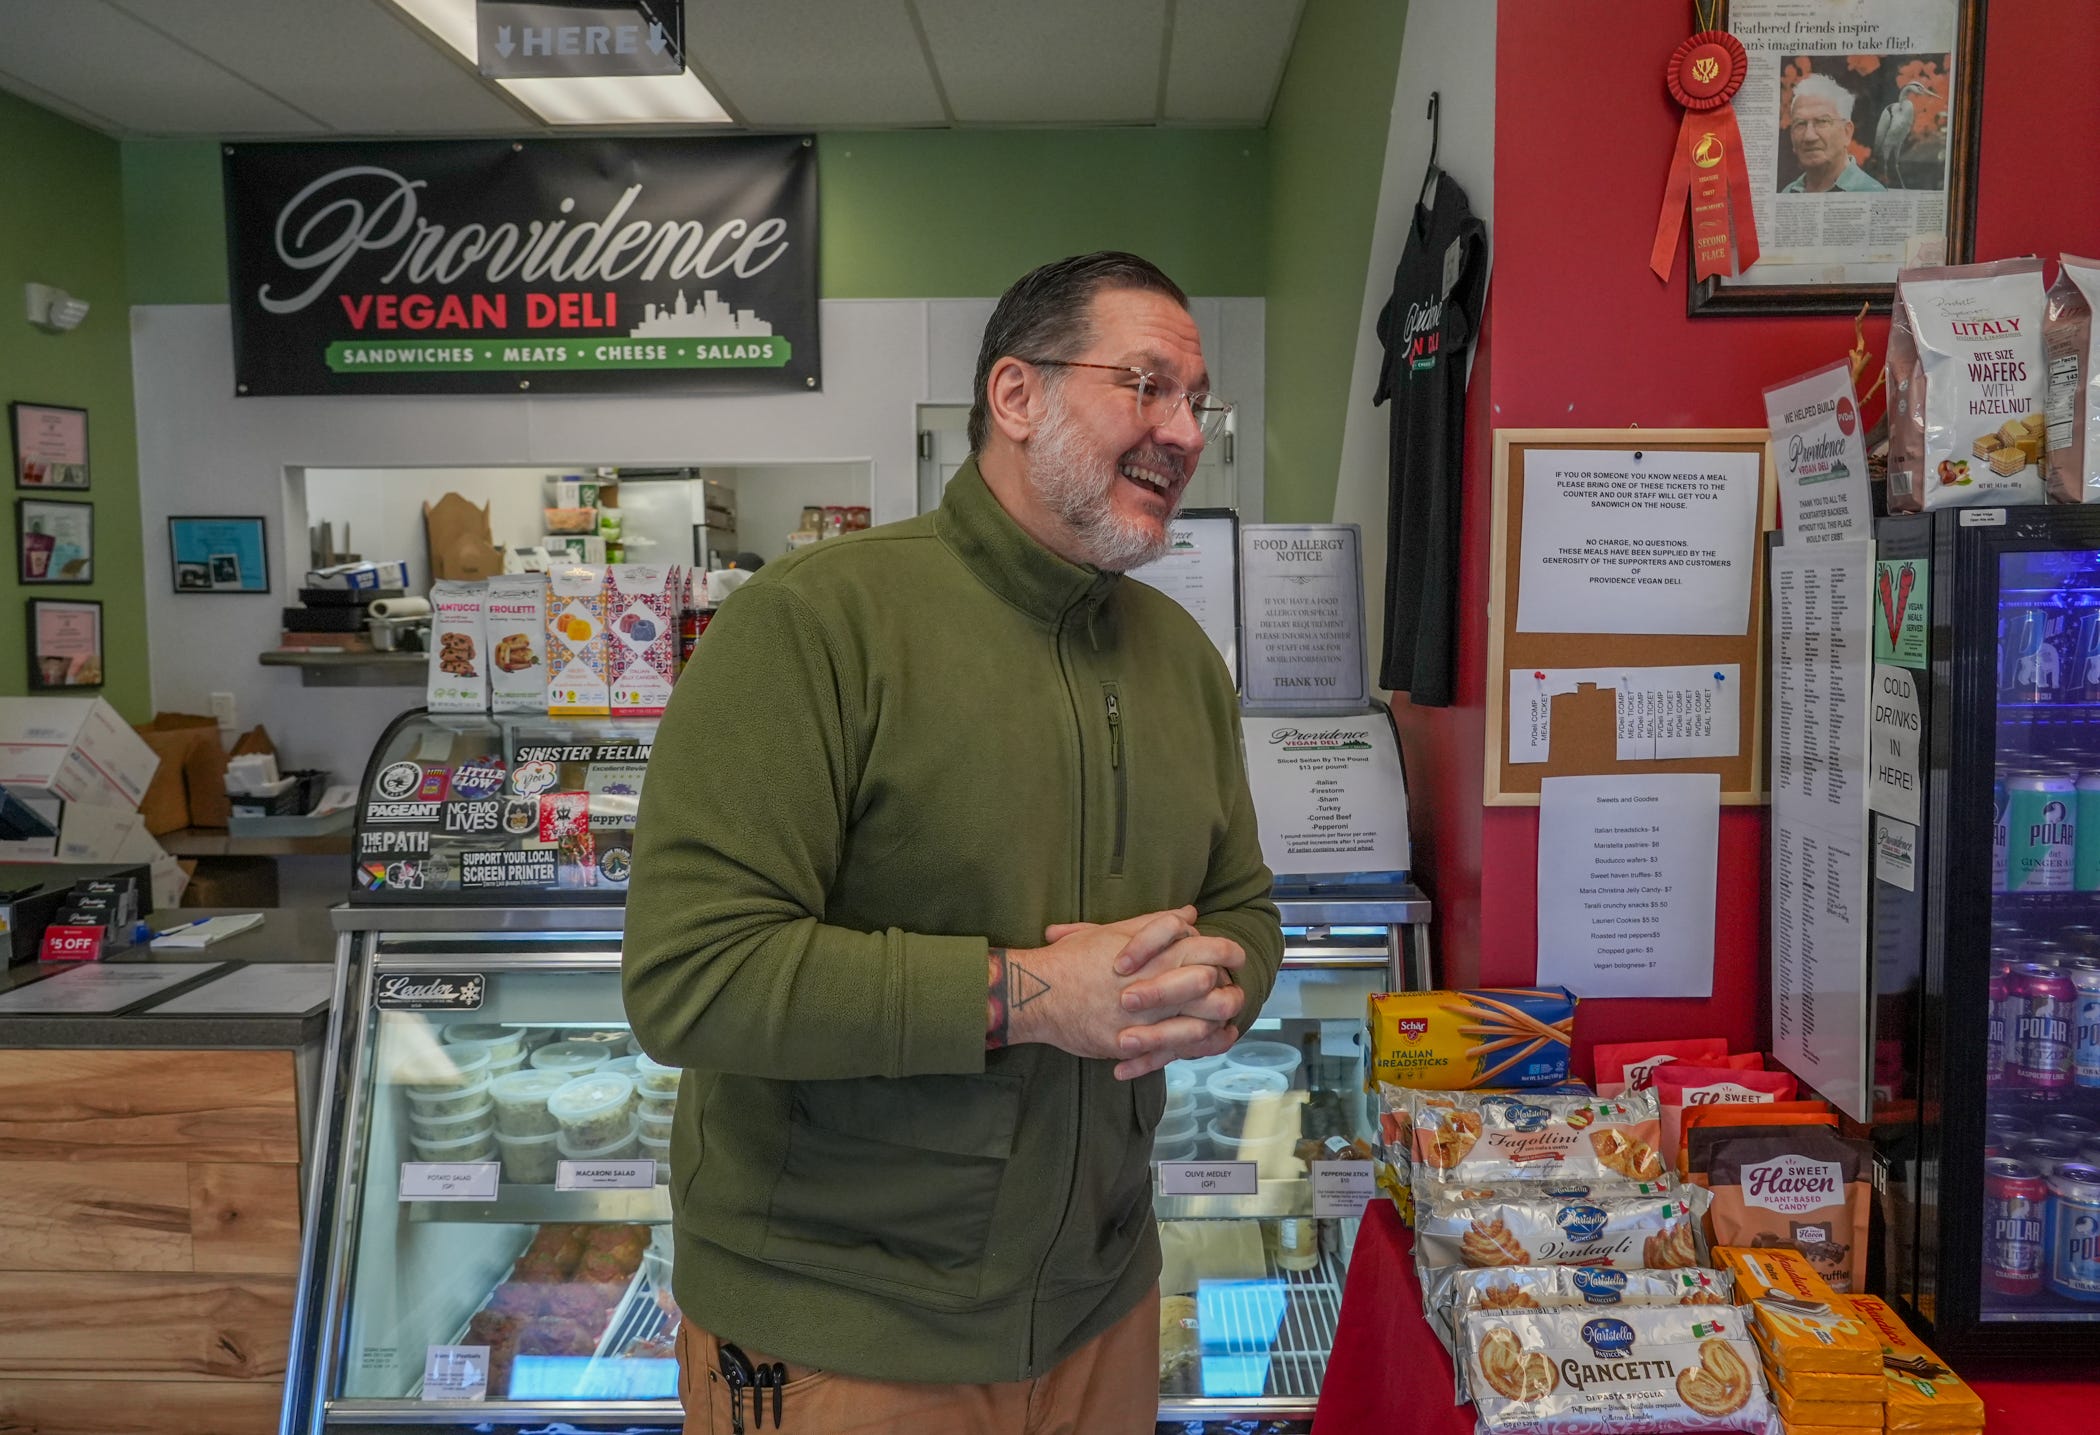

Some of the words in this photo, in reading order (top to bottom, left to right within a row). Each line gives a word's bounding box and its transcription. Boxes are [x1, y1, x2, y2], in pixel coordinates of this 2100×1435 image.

[1733, 22, 1790, 34] Feathered
[1795, 21, 1835, 33] friends
[1838, 21, 1879, 37] inspire
[523, 26, 638, 56] HERE
[1744, 39, 1764, 50] an's
[1768, 39, 1837, 52] imagination
[1842, 40, 1853, 49] to
[1858, 37, 1882, 49] take
[259, 166, 789, 313] Providence
[1698, 234, 1727, 248] SECOND
[1702, 248, 1725, 262] PLACE
[340, 294, 506, 329] VEGAN
[526, 293, 617, 328] DELI
[1952, 319, 2022, 336] LITALY
[343, 347, 474, 364] SANDWICHES
[503, 347, 568, 363] MEATS
[595, 345, 667, 361] CHEESE
[696, 344, 773, 360] SALADS
[1974, 352, 1993, 361] BITE
[1995, 350, 2015, 360] SIZE
[1968, 362, 2027, 383] WAFERS
[1982, 383, 2015, 398] WITH
[1784, 412, 1793, 424] WE
[1794, 406, 1817, 422] HELPED
[1817, 400, 1835, 416] BUILD
[1970, 398, 2032, 415] HAZELNUT
[1789, 433, 1846, 472] Providence
[1798, 462, 1817, 476] VEGAN
[1818, 461, 1829, 472] DELI
[1254, 540, 1288, 549] FOOD
[1291, 540, 1344, 551] ALLERGY
[1276, 551, 1323, 561] NOTICE
[1908, 613, 1922, 621] MEALS
[1273, 677, 1312, 686] THANK
[1314, 677, 1336, 686] YOU
[1884, 677, 1911, 699] COLD
[1875, 705, 1919, 731] DRINKS
[1269, 728, 1369, 744] Providence
[516, 747, 593, 762] SINISTER
[596, 746, 652, 760] FEELIN
[1890, 738, 1902, 757] IN
[456, 767, 506, 779] LITTLE
[1879, 765, 1913, 791] HERE!
[367, 804, 441, 816] PAGEANT
[447, 803, 467, 814] NC
[468, 802, 498, 813] EMO
[446, 812, 498, 831] LIVES
[361, 833, 382, 845] THE
[384, 831, 429, 852] PATH
[2030, 824, 2073, 846] POLAR
[463, 853, 501, 865] SUPPORT
[502, 852, 526, 864] YOUR
[528, 851, 555, 863] LOCAL
[463, 866, 505, 882] SCREEN
[508, 865, 555, 880] PRINTER
[50, 938, 63, 950] $5
[64, 938, 92, 950] OFF
[380, 976, 461, 999] Leader
[1400, 1021, 1425, 1031] Schär
[2019, 1017, 2067, 1042] POLAR
[1392, 1050, 1433, 1059] ITALIAN
[1724, 1093, 1762, 1103] SWEET
[1488, 1132, 1579, 1153] Fagottini
[1788, 1166, 1828, 1175] SWEET
[1201, 1180, 1216, 1188] (GF)
[1749, 1167, 1835, 1196] Haven
[1995, 1217, 2040, 1242] POLAR
[1538, 1236, 1632, 1260] Ventagli
[1574, 1271, 1624, 1287] Maristella
[1583, 1326, 1632, 1343] Maristella
[1561, 1359, 1675, 1391] GANCETTI
[1597, 1393, 1625, 1401] PASTA
